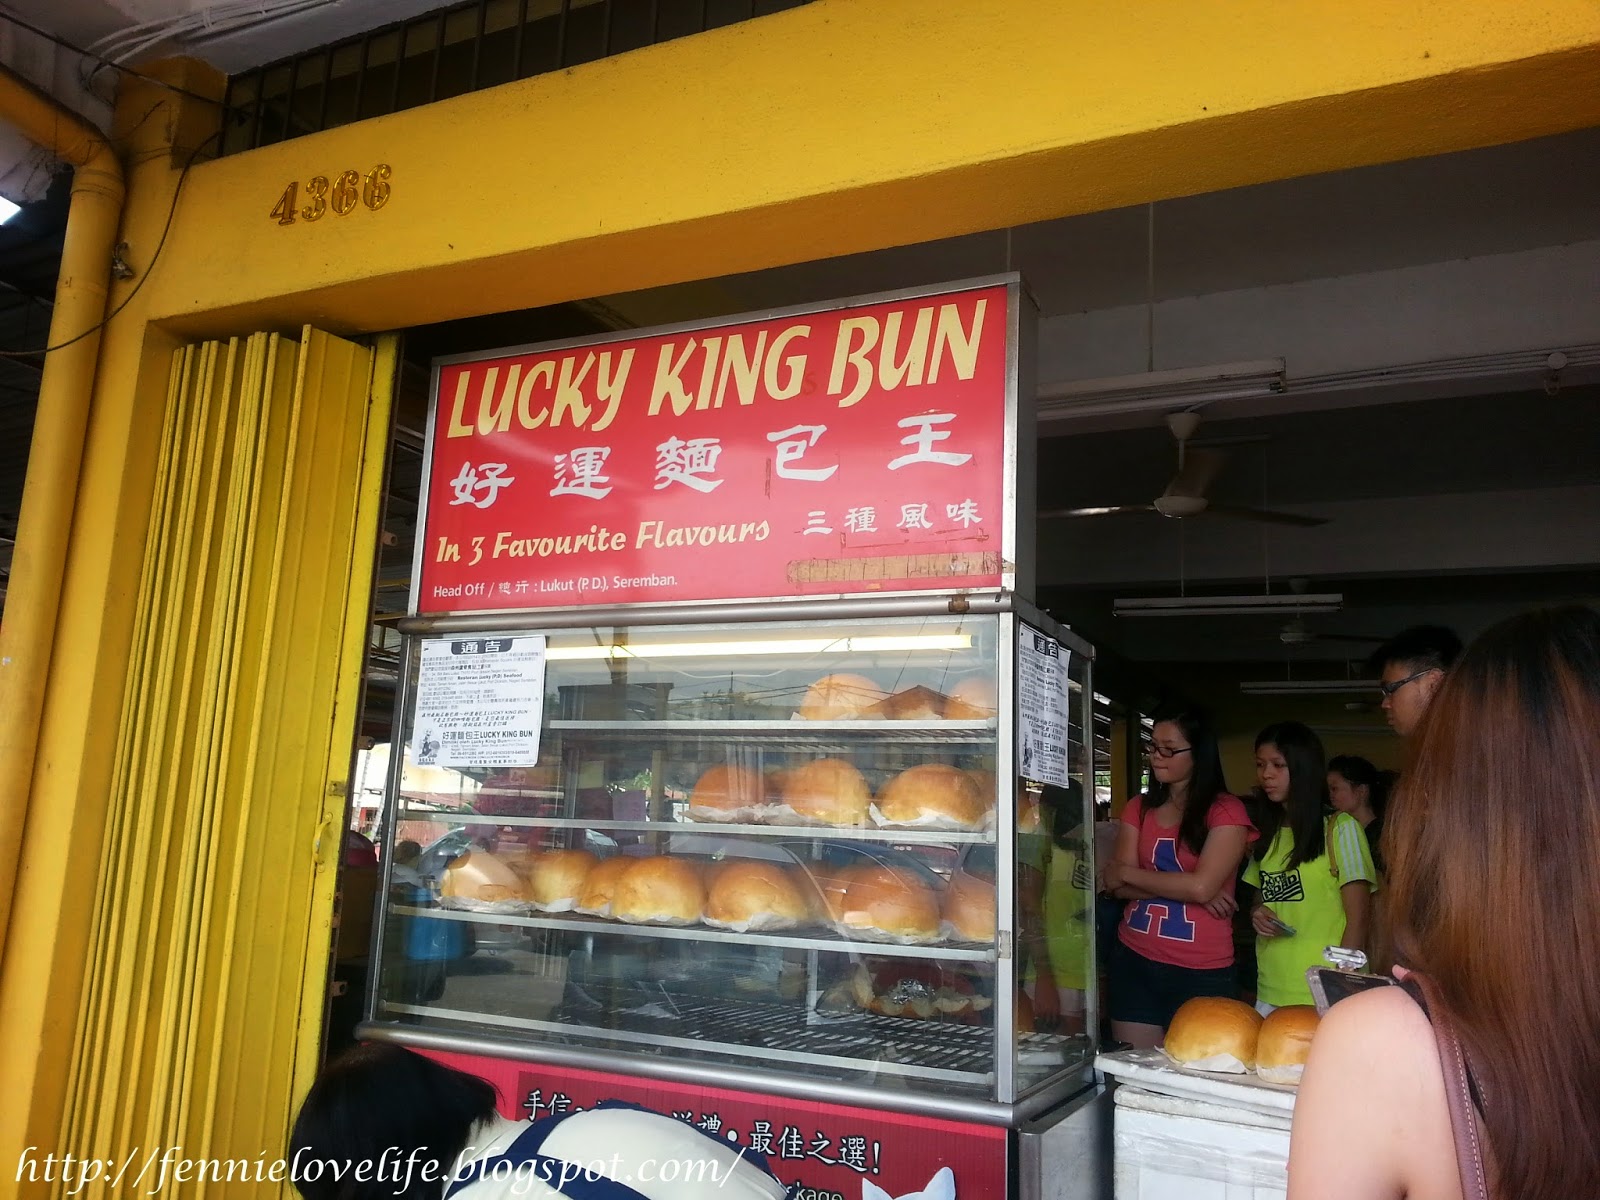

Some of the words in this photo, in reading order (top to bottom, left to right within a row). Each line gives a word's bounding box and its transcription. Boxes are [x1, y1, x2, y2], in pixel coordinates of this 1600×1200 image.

[269, 163, 392, 227] 4366
[447, 348, 636, 439] LUCKY
[647, 325, 811, 417] KING
[826, 299, 988, 409] BUN
[448, 412, 973, 509] 好運麵包王
[802, 498, 984, 537] 三種風味
[435, 536, 461, 563] In
[468, 535, 486, 566] 3
[492, 524, 627, 559] Favourite
[636, 519, 771, 549] Flavours
[433, 584, 462, 598] Head
[465, 582, 485, 596] Off
[540, 579, 574, 593] Lukut
[612, 573, 678, 589] Seremban.
[460, 641, 502, 655] 通告
[480, 730, 501, 739] LUCKY
[501, 730, 518, 738] KING
[519, 730, 533, 738] BUN
